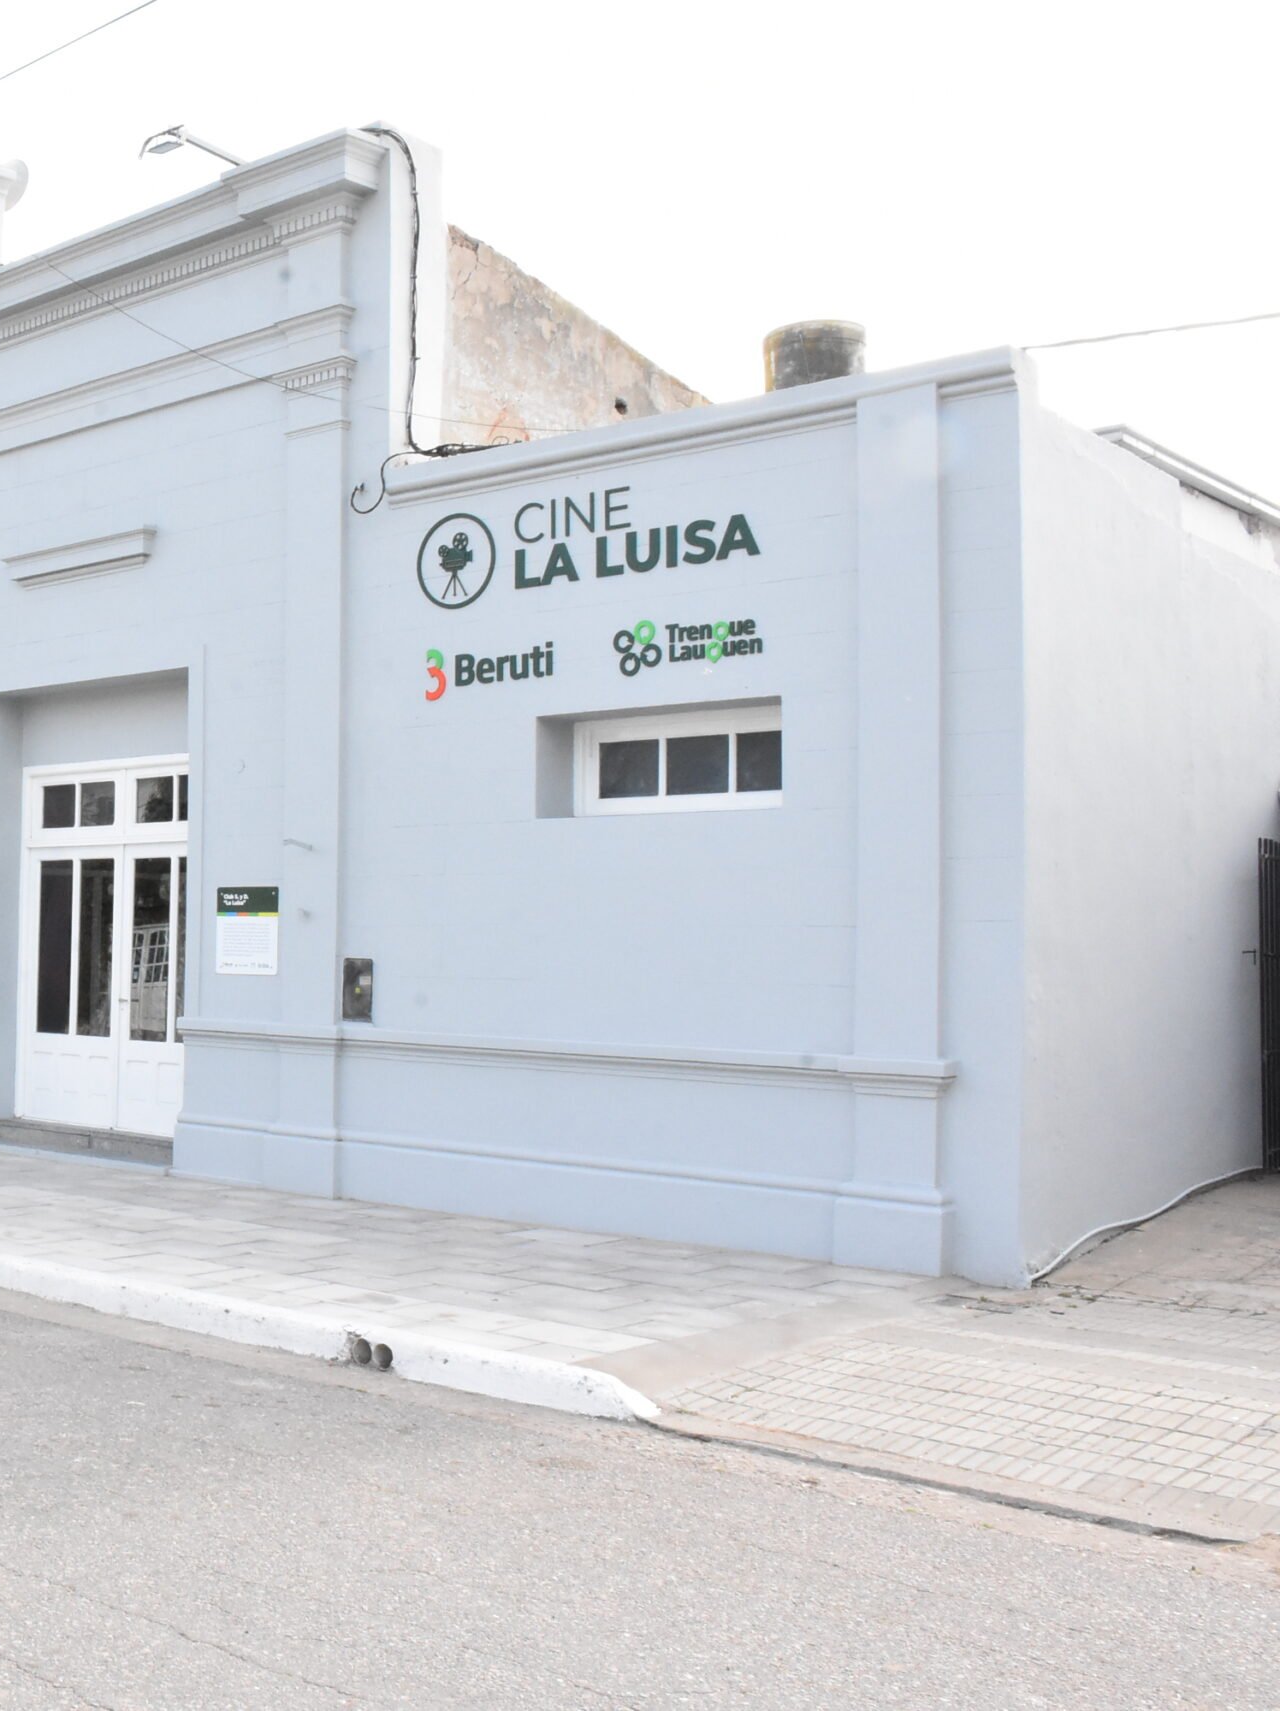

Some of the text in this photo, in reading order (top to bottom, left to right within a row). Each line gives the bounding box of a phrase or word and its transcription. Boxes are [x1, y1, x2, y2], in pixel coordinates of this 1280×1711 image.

[514, 485, 632, 544] CINE
[514, 513, 761, 590] LA LUISA
[665, 618, 756, 643] Trenque
[669, 637, 763, 664] Lauquen
[455, 641, 554, 687] Beruti
